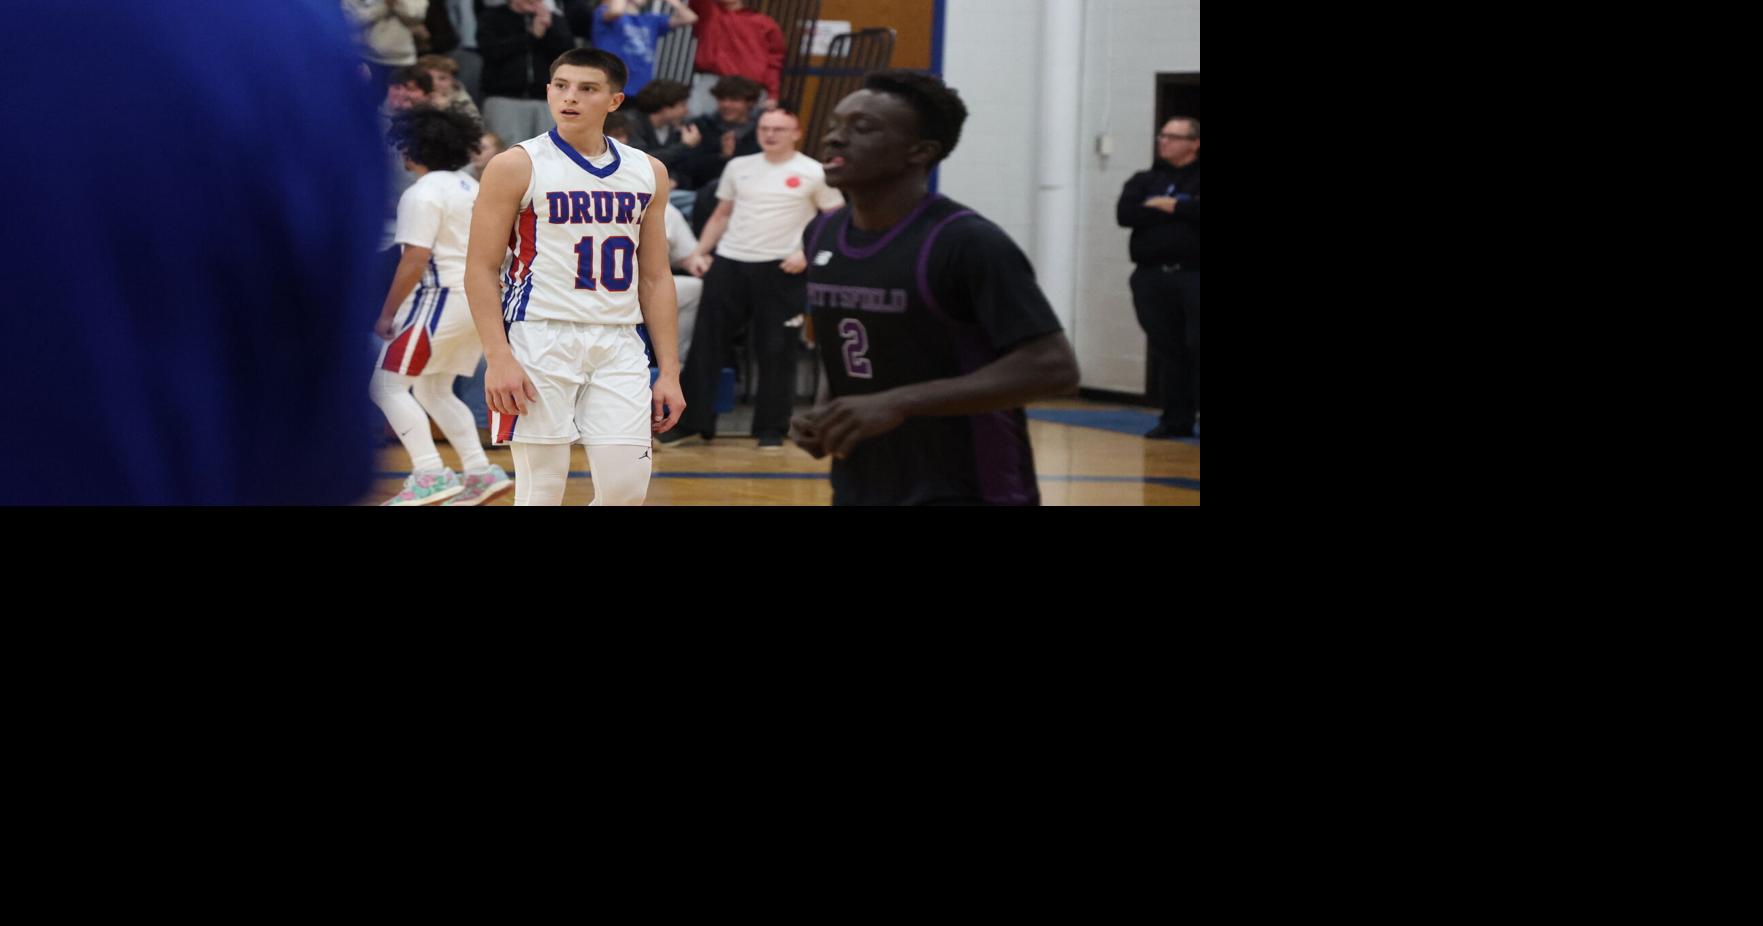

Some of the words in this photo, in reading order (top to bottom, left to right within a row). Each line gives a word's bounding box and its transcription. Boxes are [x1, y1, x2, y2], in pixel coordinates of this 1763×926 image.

[546, 190, 652, 225] DRURY
[573, 235, 636, 293] 10
[838, 318, 873, 379] 2
